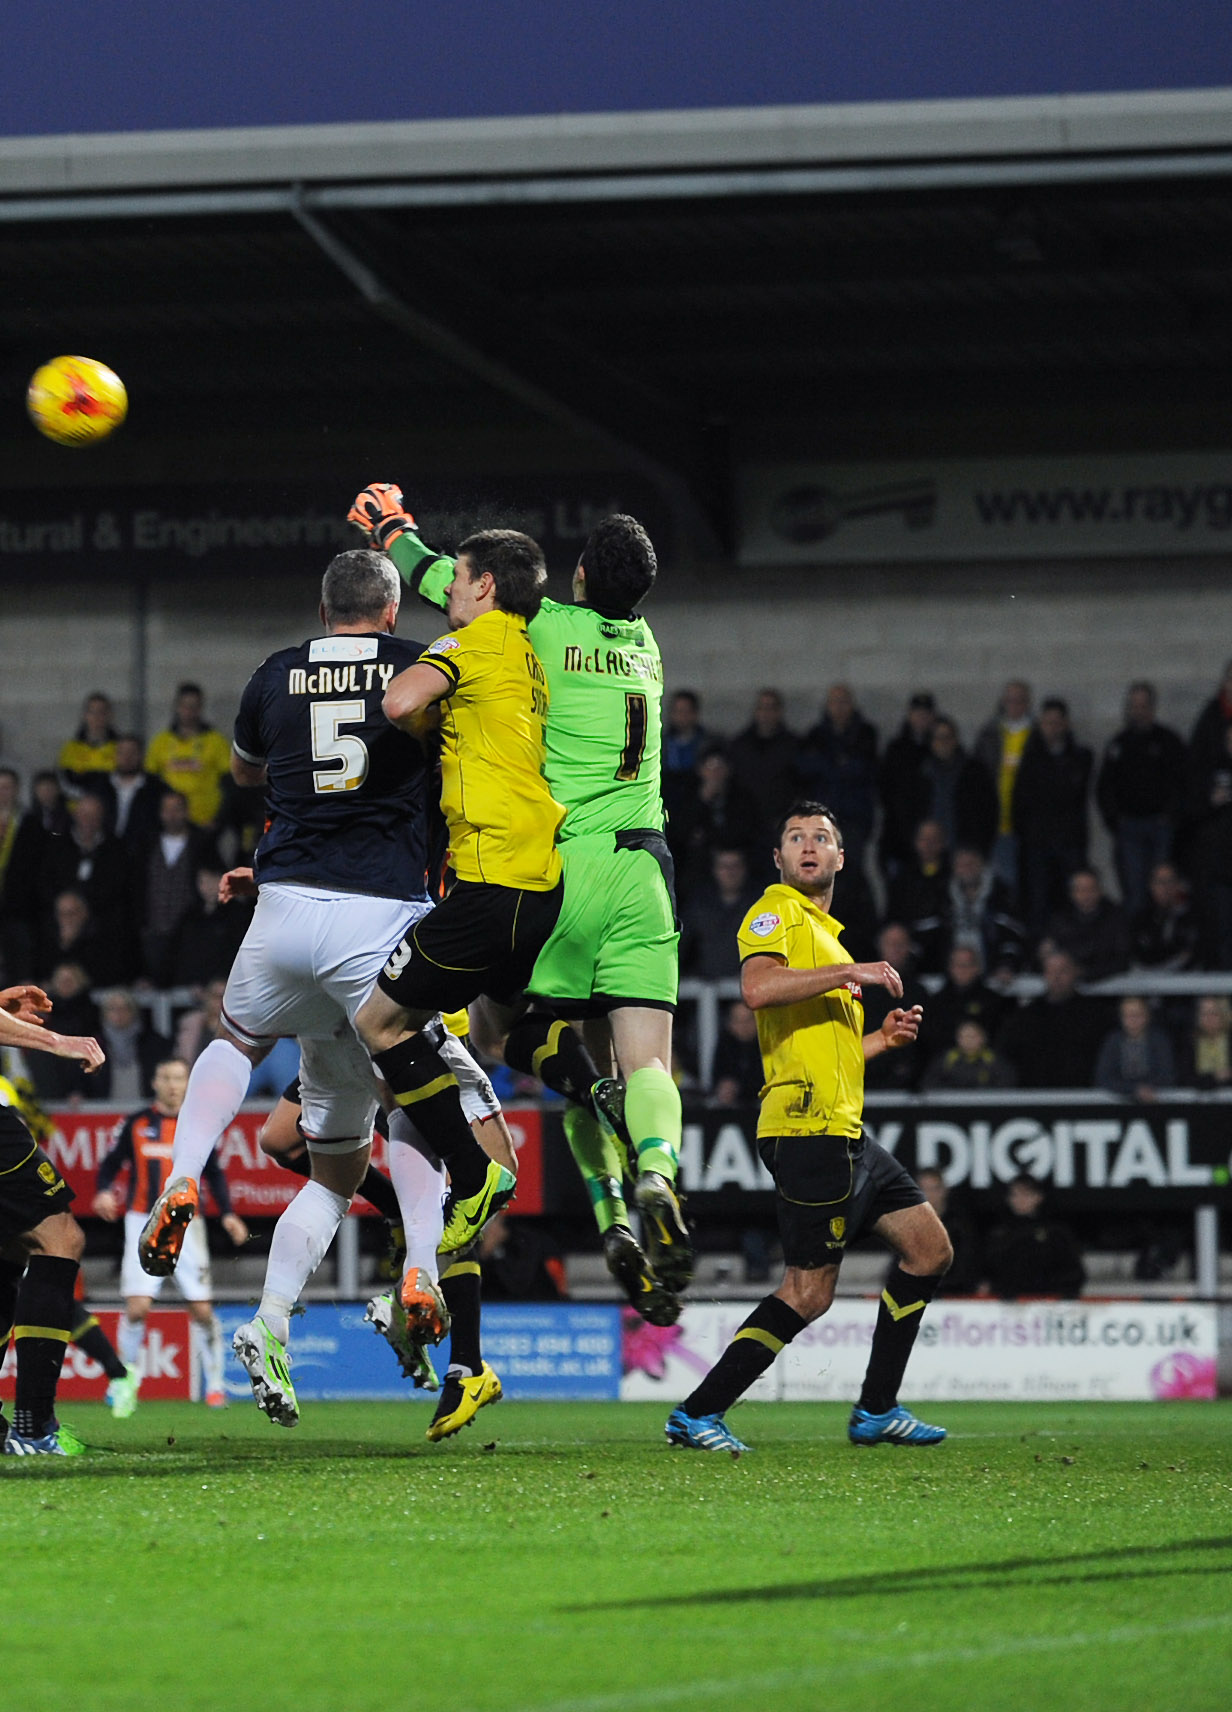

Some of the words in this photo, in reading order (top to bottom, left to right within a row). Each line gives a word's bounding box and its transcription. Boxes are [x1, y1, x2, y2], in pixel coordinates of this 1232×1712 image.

[92, 512, 120, 550] &
[309, 699, 370, 795] 5
[617, 692, 647, 781] 1
[916, 1117, 1232, 1188] DIGITAL.
